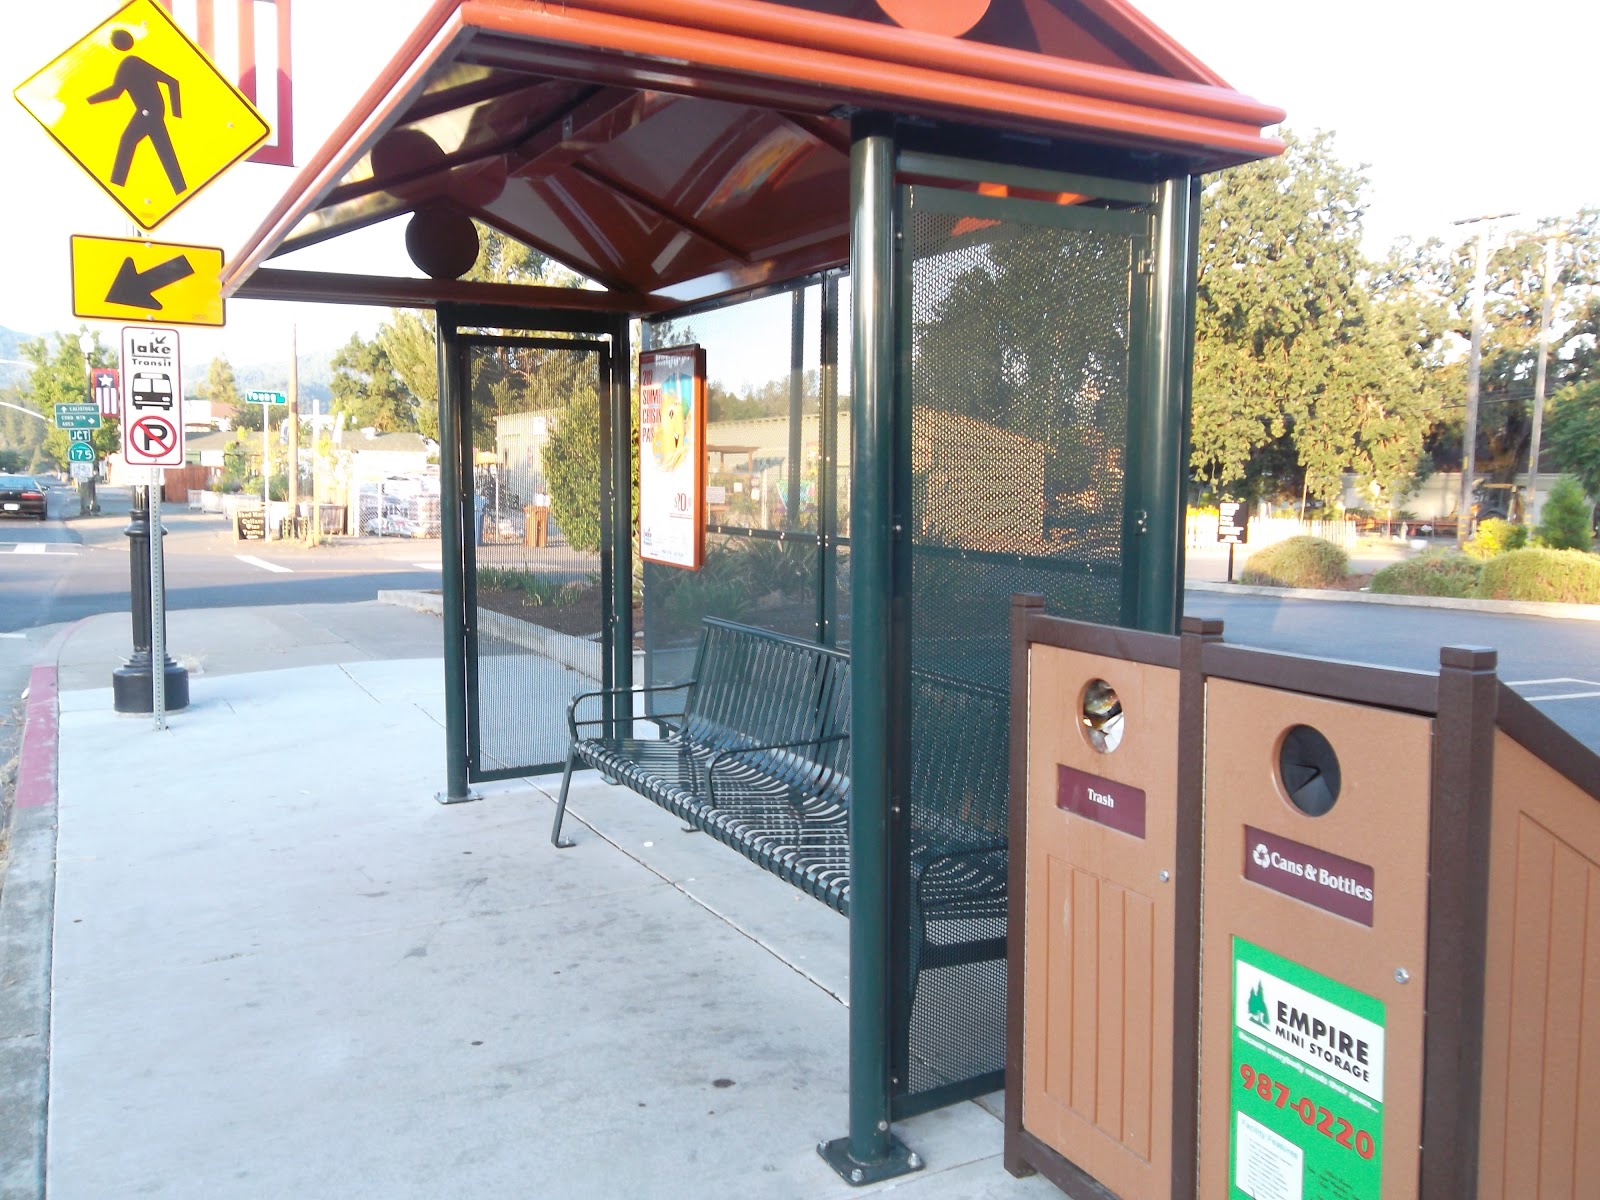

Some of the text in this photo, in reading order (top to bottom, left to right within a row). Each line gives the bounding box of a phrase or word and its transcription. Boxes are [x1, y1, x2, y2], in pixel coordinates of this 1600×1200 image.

[132, 358, 171, 367] Transit
[72, 431, 88, 440] JCT
[71, 450, 92, 460] 175
[1087, 788, 1114, 808] Trash
[1271, 852, 1373, 901] Cans & Bottles
[1277, 1000, 1368, 1066] EMPIRE
[1275, 1025, 1369, 1083] MINI STORAGE
[1239, 1063, 1375, 1161] 987-0220
